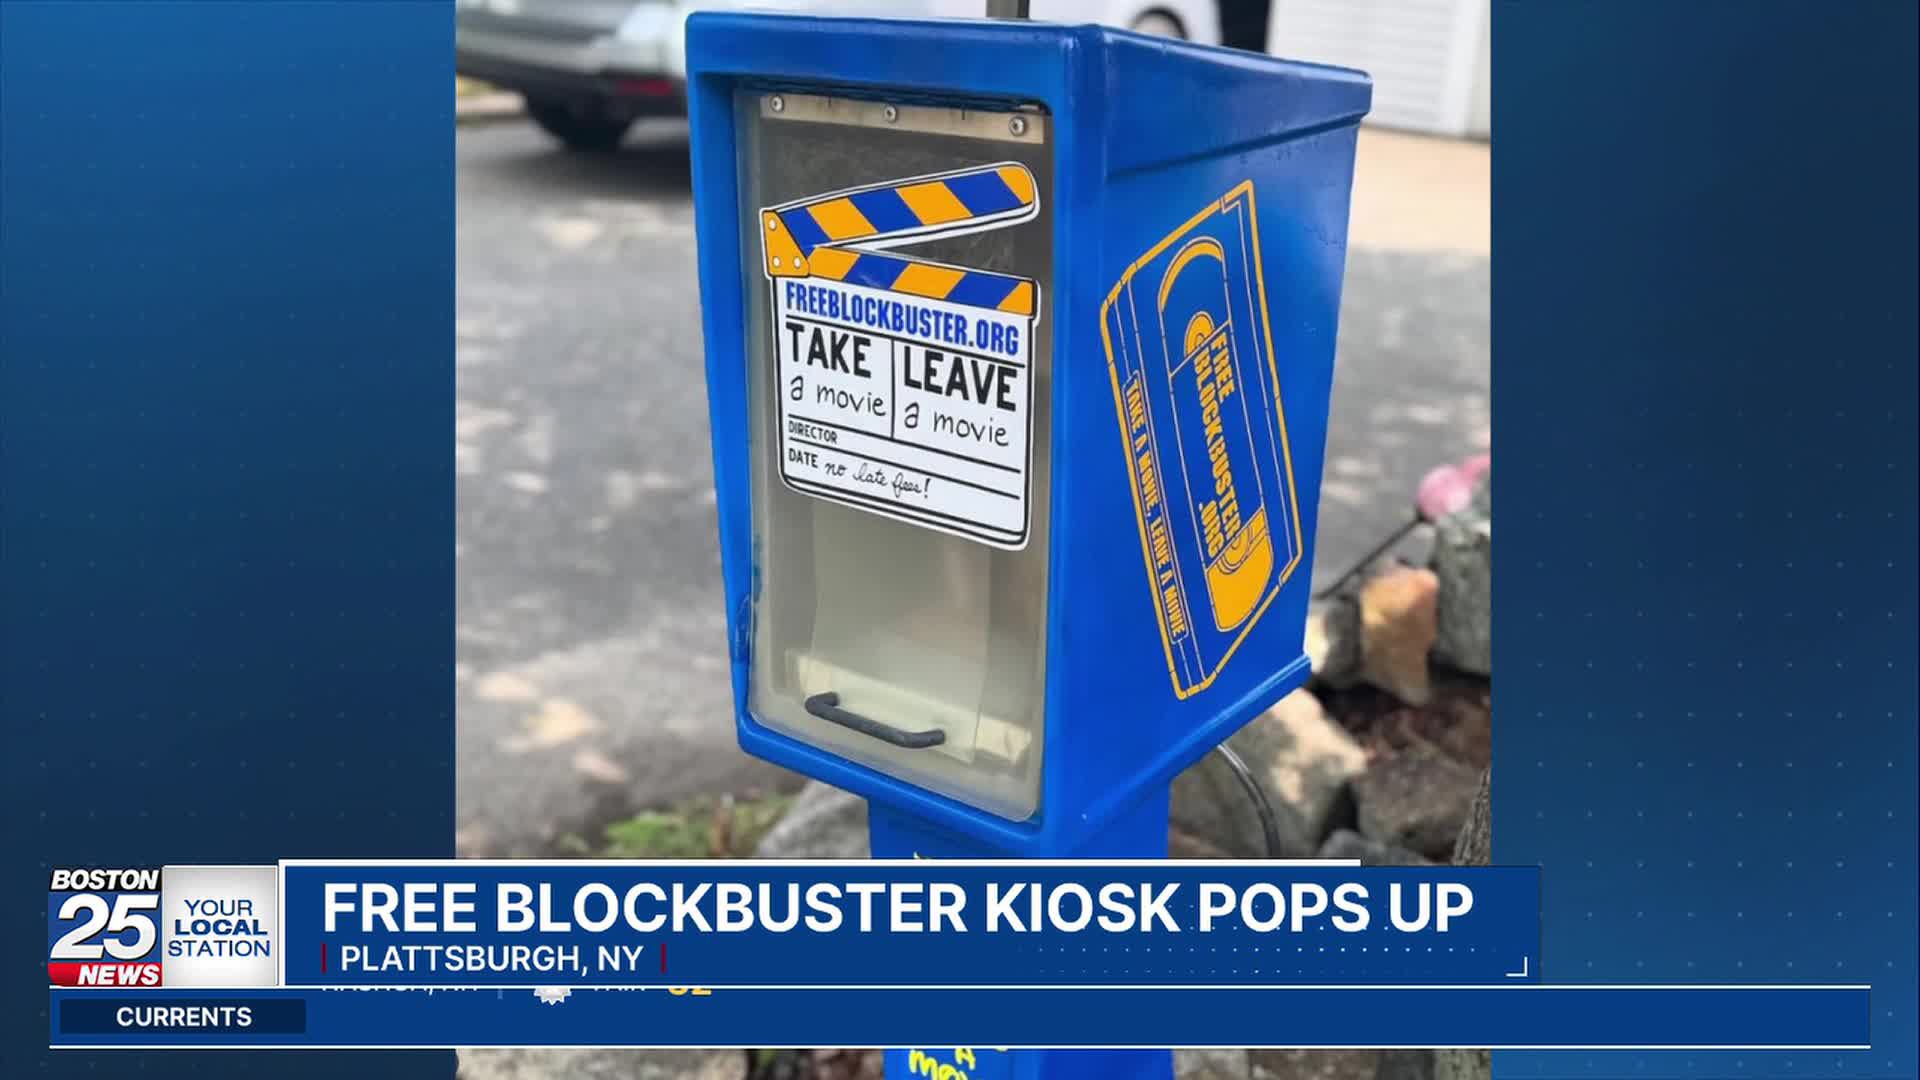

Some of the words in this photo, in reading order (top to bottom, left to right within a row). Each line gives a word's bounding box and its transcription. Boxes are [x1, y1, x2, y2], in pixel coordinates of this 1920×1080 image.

[785, 281, 1020, 355] FREEBLOCKBUSTER.ORG
[786, 322, 872, 378] TAKE
[1210, 332, 1235, 404] FREE
[789, 375, 804, 402] a
[816, 383, 887, 417] movie
[903, 346, 1017, 412] LEAVE
[1126, 378, 1148, 434] TAKE
[788, 420, 838, 444] DIRECTOR
[904, 402, 920, 429] a
[933, 412, 1009, 447] movie
[1135, 433, 1149, 453] A
[1194, 346, 1241, 541] BLOCKBUSTER
[788, 447, 819, 469] DATE
[825, 462, 848, 477] no
[853, 462, 888, 486] late
[892, 472, 932, 499] fees!
[1150, 515, 1171, 569] LEAVE
[1198, 499, 1225, 559] .ORG
[1160, 569, 1174, 586] A
[1164, 585, 1186, 638] MOVIE
